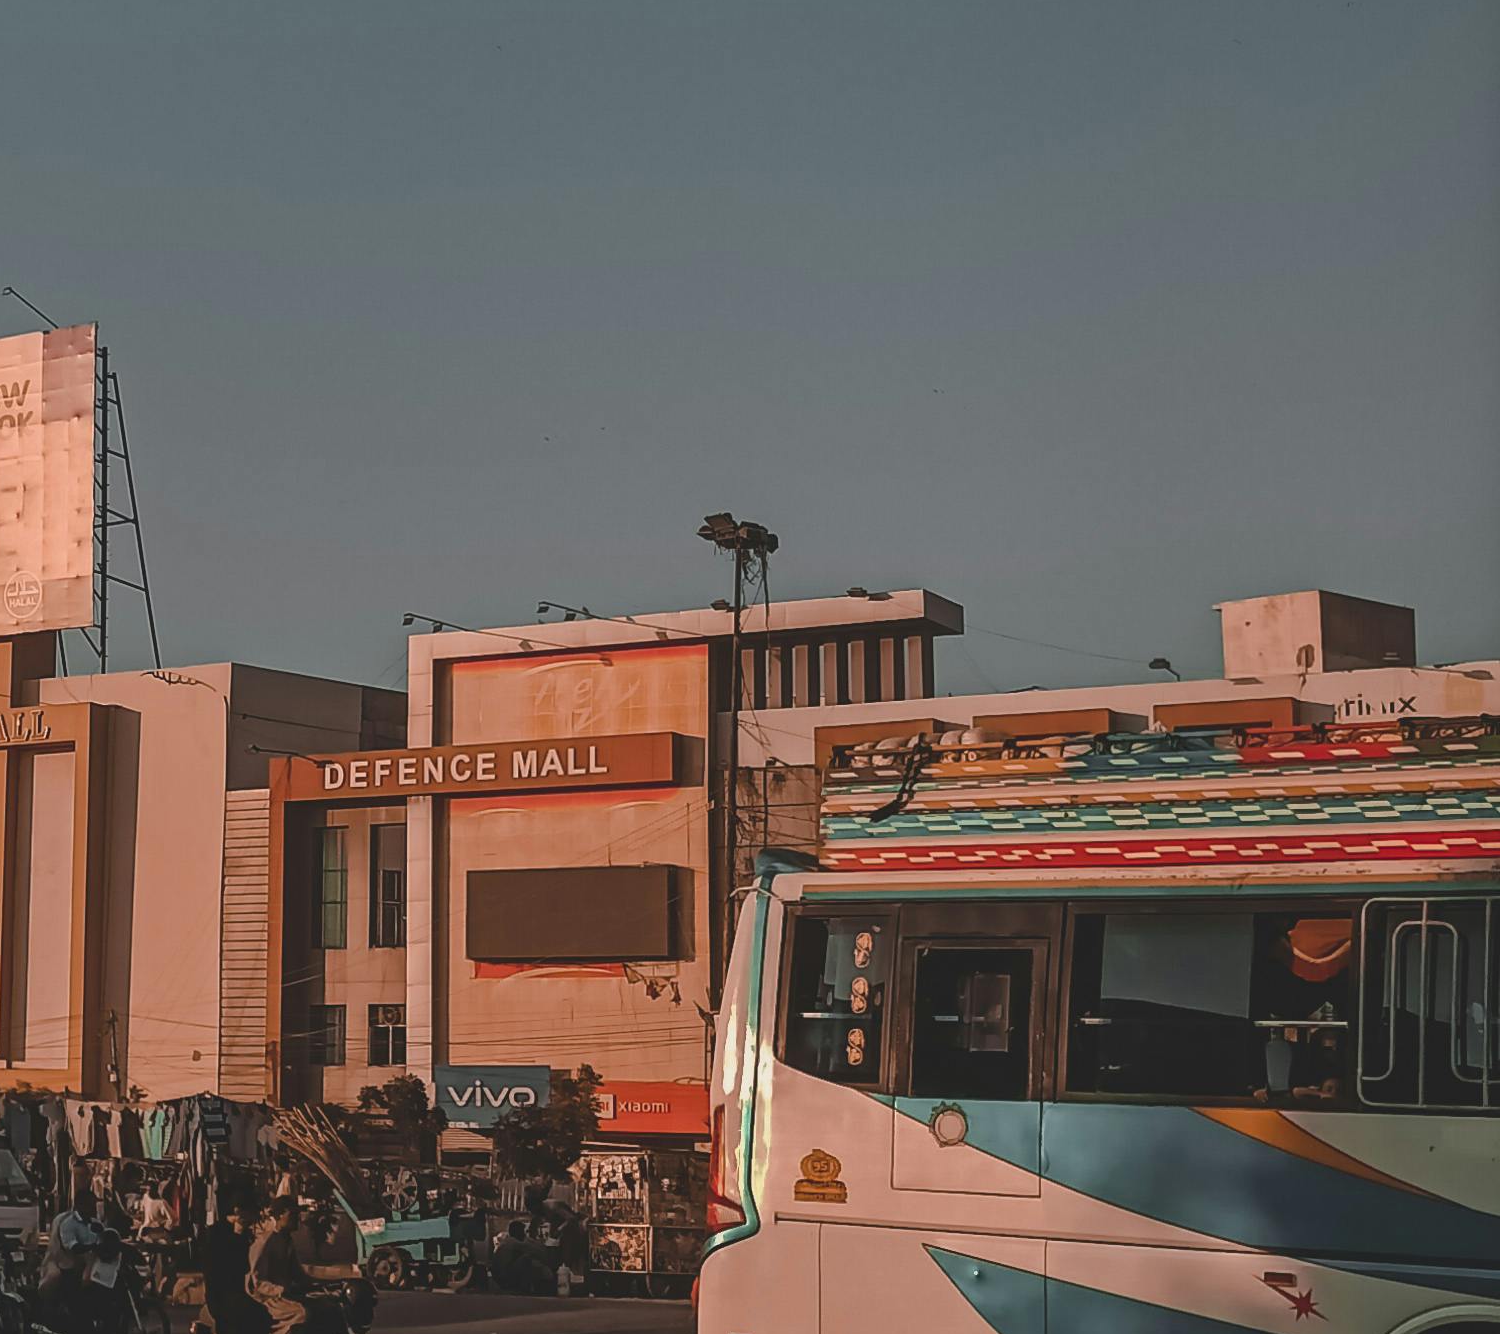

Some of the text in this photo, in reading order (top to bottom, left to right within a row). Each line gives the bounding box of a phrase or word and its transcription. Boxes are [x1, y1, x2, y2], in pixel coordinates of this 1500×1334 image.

[9, 597, 37, 608] HALAL
[323, 745, 608, 790] DEFENCE MALL
[447, 1078, 536, 1108] vivo
